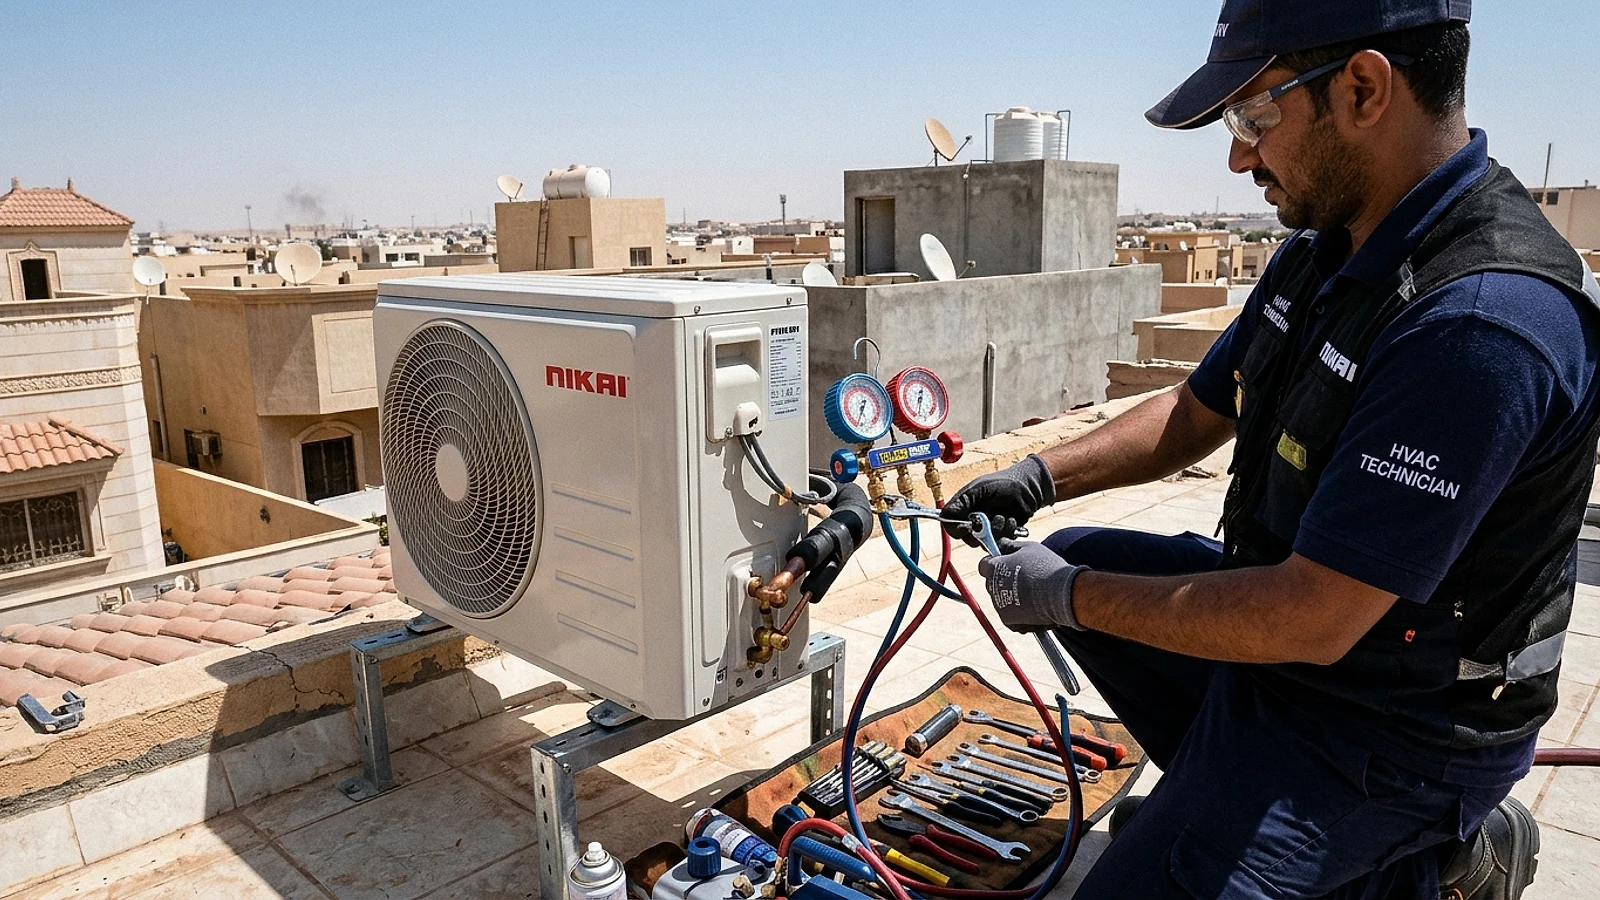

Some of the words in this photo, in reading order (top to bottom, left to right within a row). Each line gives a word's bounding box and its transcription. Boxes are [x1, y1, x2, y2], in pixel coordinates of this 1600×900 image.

[546, 365, 627, 398] NIKAI
[1389, 443, 1440, 471] HVAC
[1360, 453, 1460, 500] TECHNICIAN
